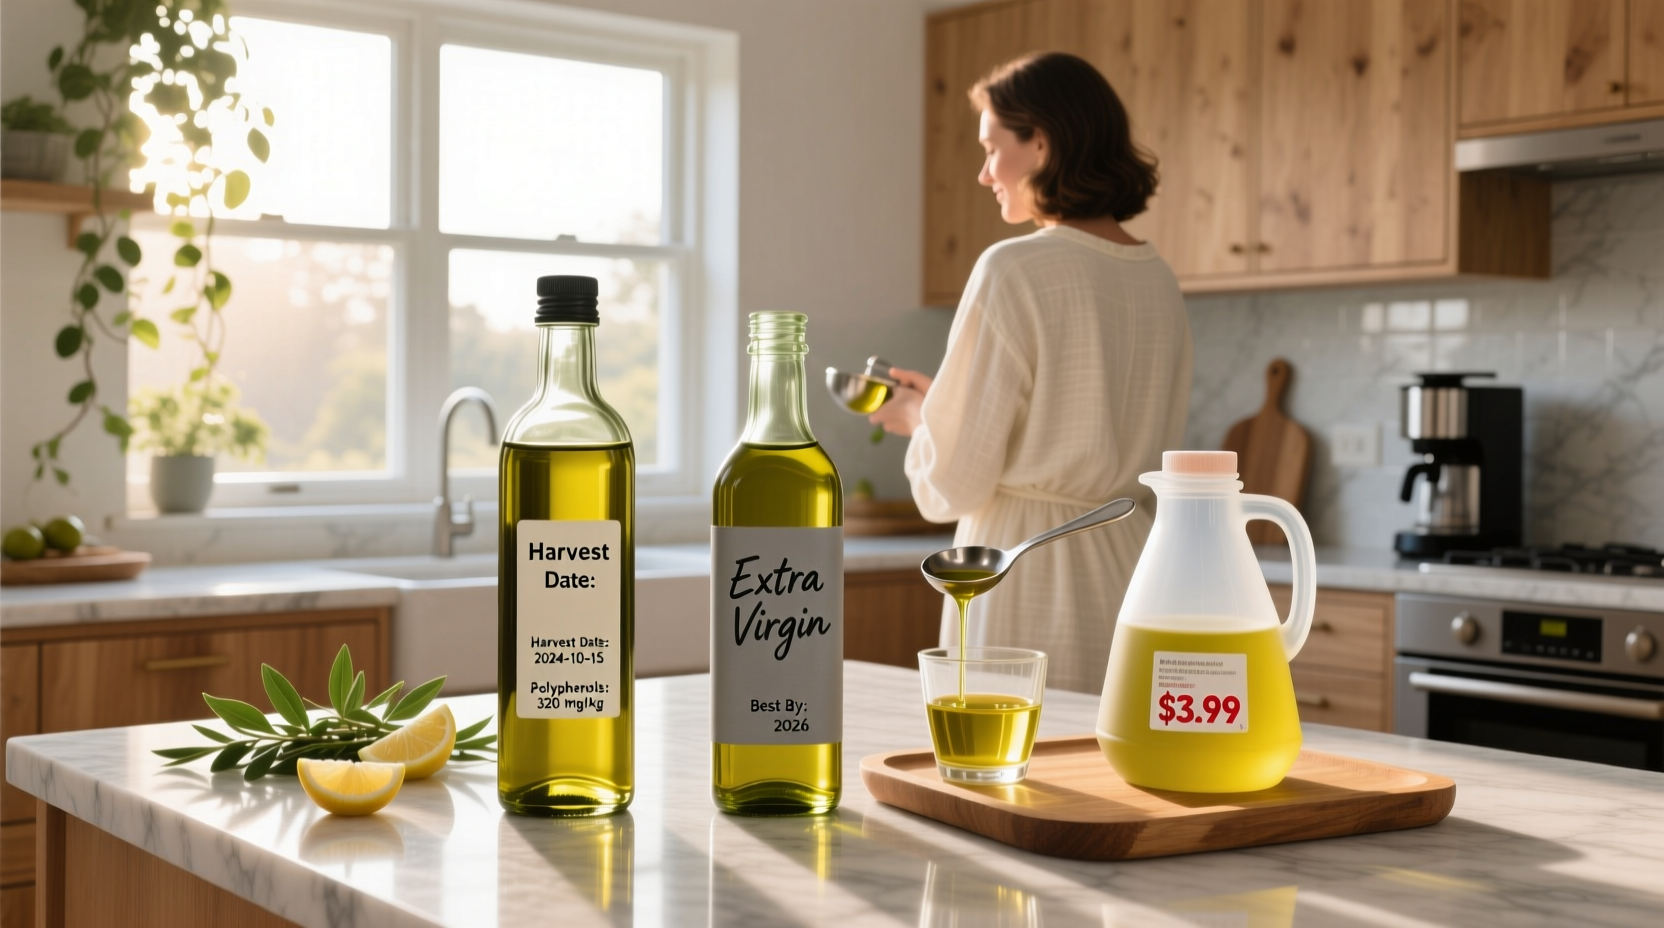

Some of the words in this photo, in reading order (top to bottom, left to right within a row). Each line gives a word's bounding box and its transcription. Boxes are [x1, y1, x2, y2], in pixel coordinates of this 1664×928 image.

[529, 542, 610, 561] Harvest
[545, 570, 596, 589] Date:
[729, 555, 825, 600] Extra
[734, 600, 832, 661] Virgin
[531, 635, 576, 649] Harvest
[534, 651, 604, 664] 2024-10-15
[537, 697, 560, 710] 320
[750, 699, 781, 713] Best
[785, 699, 808, 717] By:
[1158, 690, 1241, 727] $3.99
[773, 718, 810, 733] 2026
